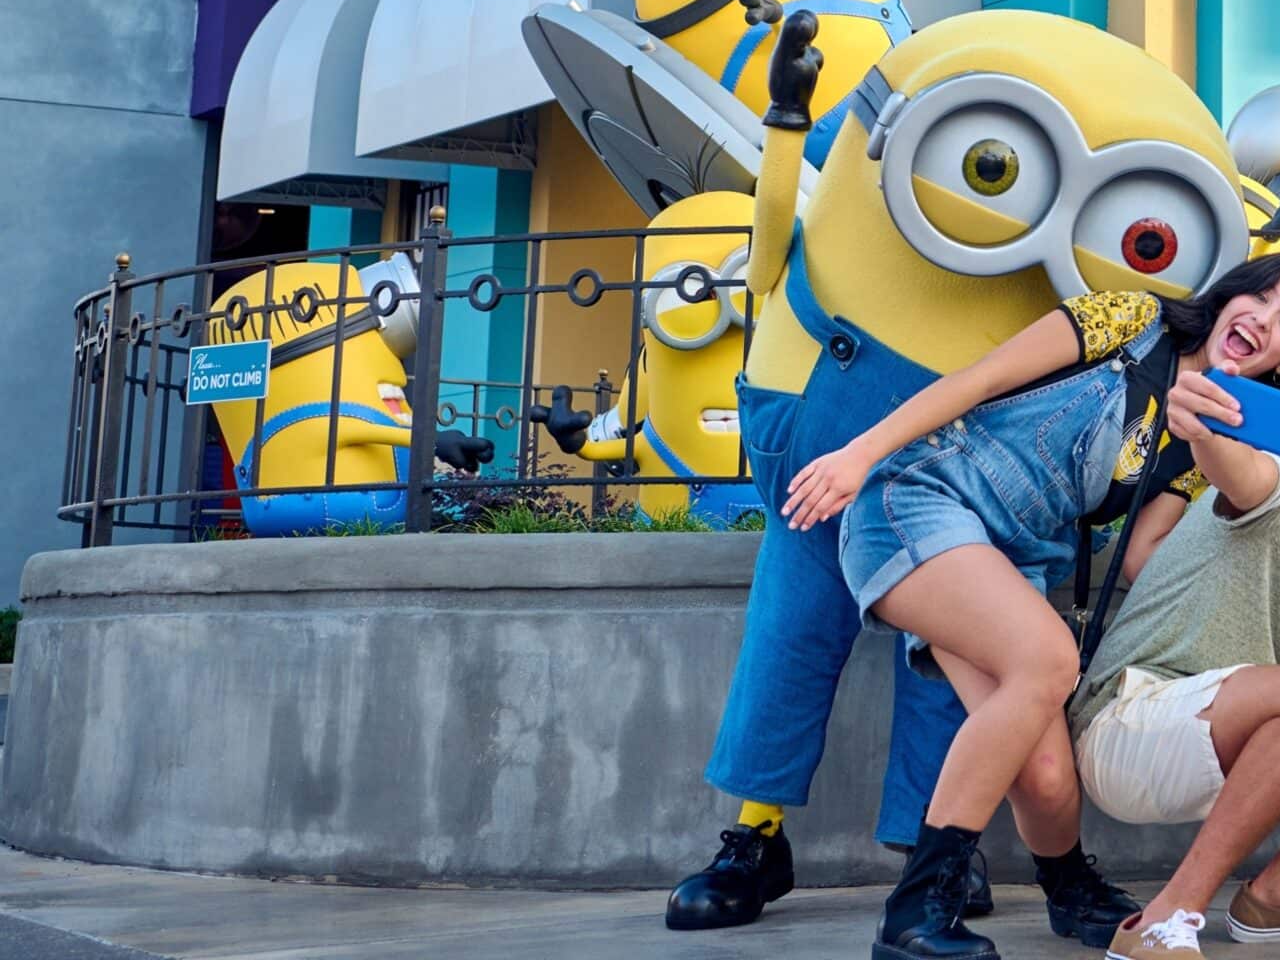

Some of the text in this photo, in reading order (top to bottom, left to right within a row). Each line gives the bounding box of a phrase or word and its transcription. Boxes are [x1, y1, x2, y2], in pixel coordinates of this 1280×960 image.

[193, 371, 262, 391] DO NOT CLIMB
